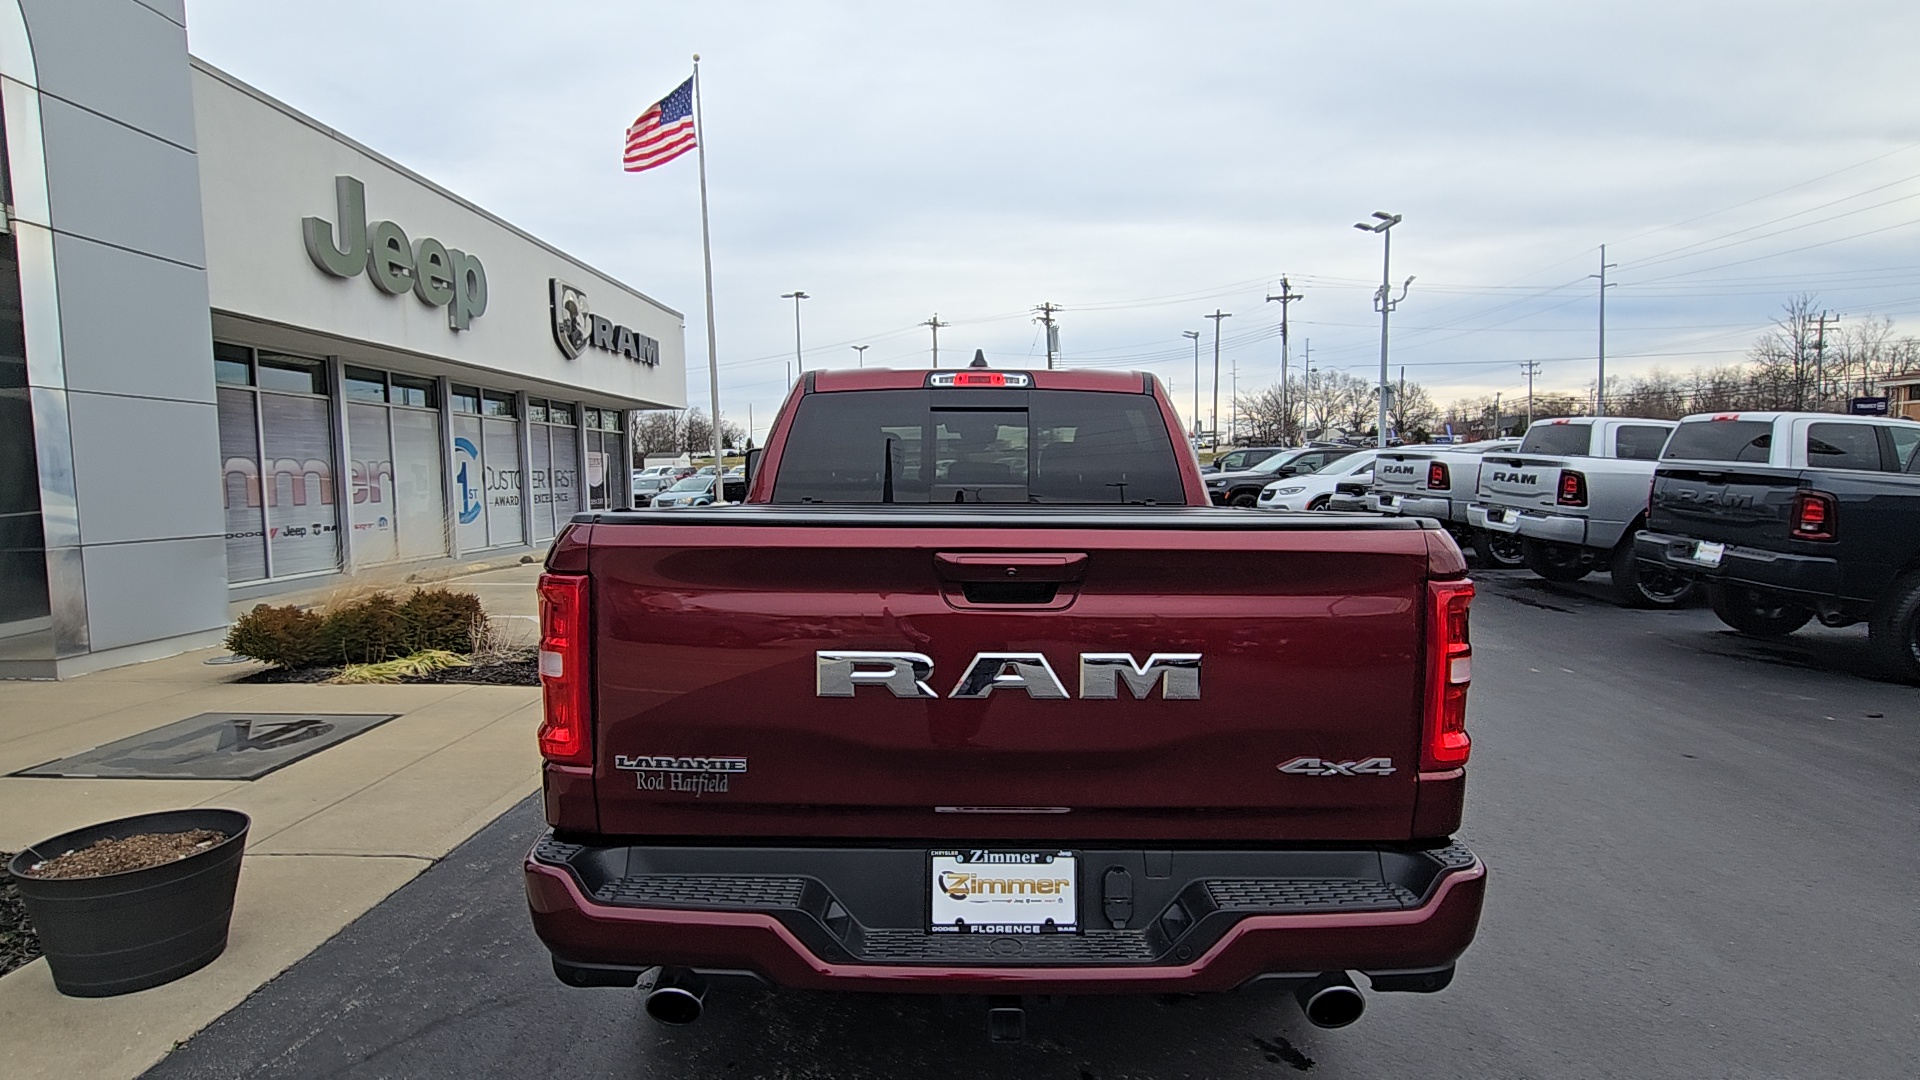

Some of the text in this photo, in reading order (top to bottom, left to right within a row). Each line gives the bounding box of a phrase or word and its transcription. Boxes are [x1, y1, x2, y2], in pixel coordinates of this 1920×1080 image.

[302, 175, 488, 331] Jeep
[589, 314, 660, 366] RAM
[482, 465, 546, 491] CUSTOER
[1383, 465, 1414, 475] RAM
[1492, 471, 1538, 485] RAM
[494, 492, 568, 507] AWARD EXCELENCE
[1676, 488, 1754, 509] RAM
[225, 531, 265, 539] DODG
[283, 525, 307, 538] Jeep
[323, 524, 337, 532] RA
[815, 650, 1204, 700] RAM
[615, 754, 748, 773] LARAMIE
[635, 771, 729, 798] Rod Hatfield
[969, 849, 1039, 863] Zimmer
[946, 872, 1070, 896] Zimmer
[970, 925, 1041, 933] FLORENCE
